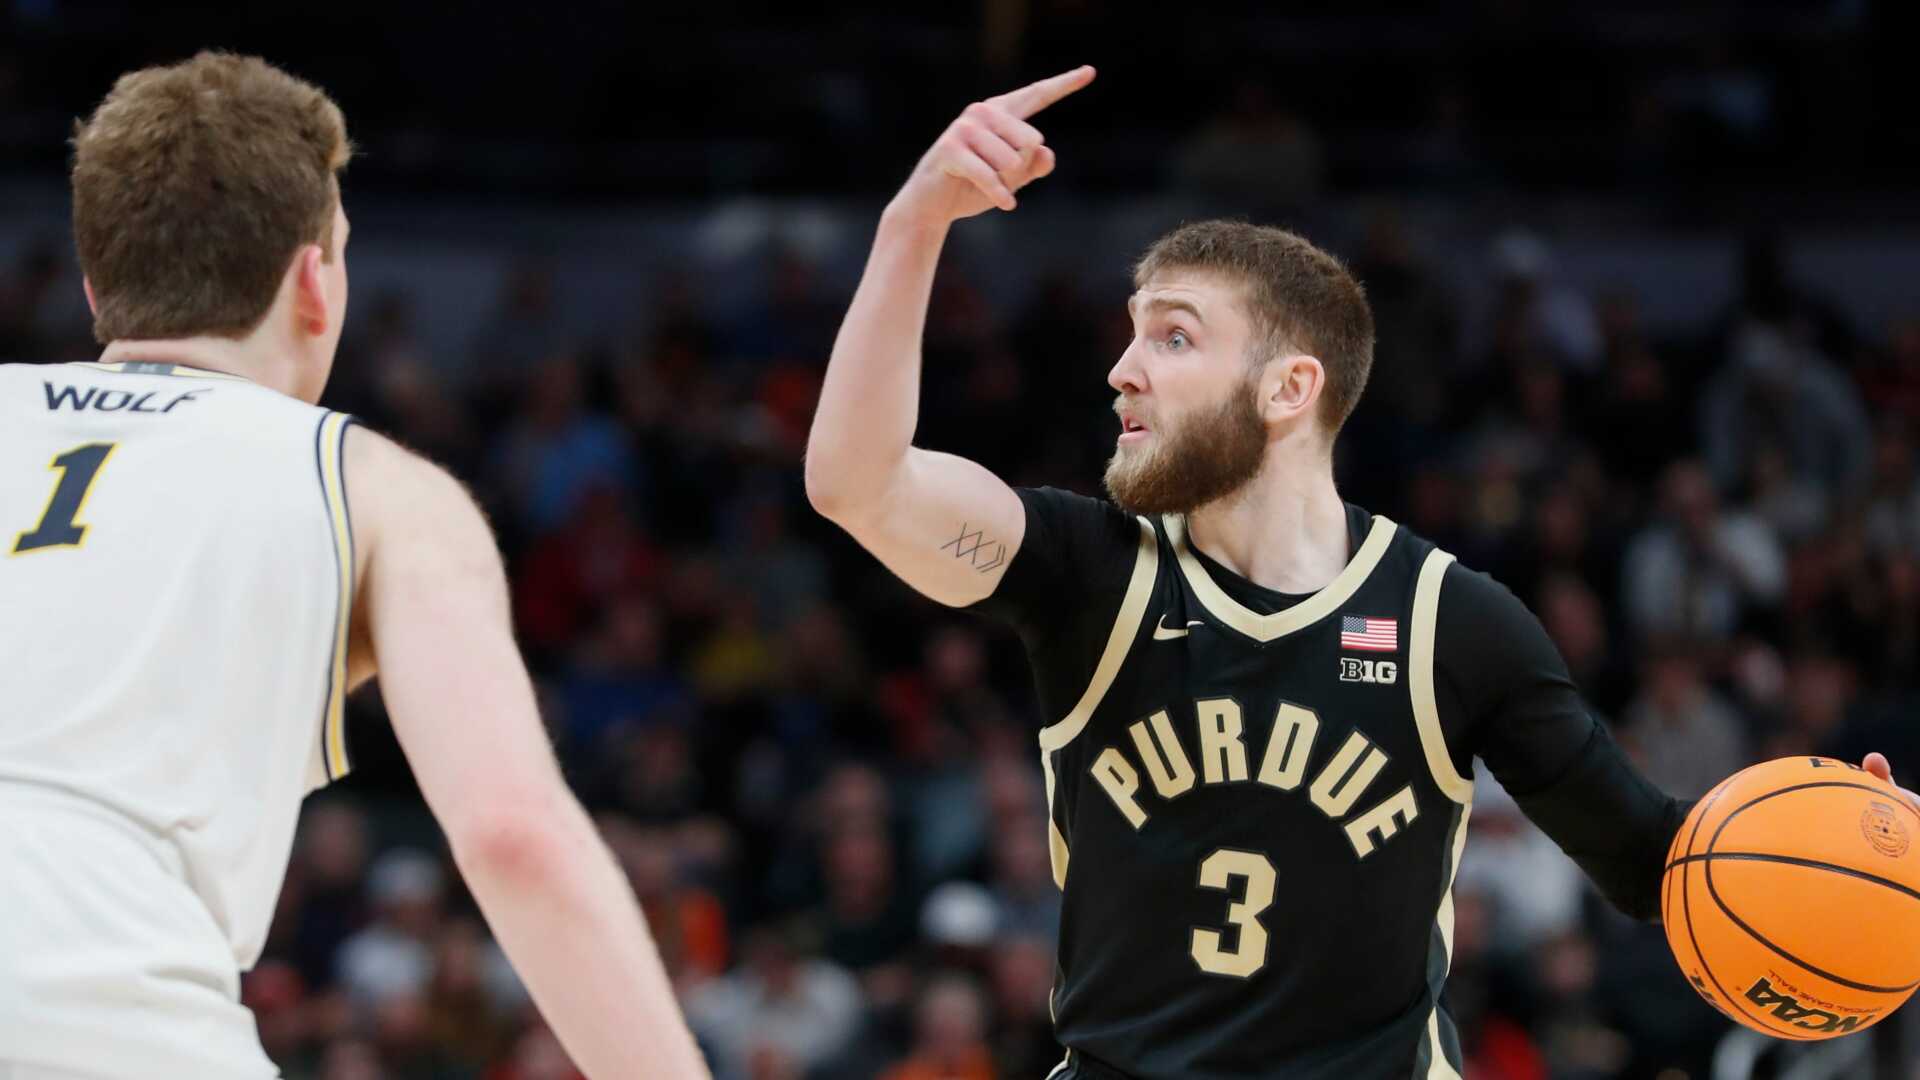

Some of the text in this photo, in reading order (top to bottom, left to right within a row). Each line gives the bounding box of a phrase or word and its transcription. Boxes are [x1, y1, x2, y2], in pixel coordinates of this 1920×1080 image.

[43, 380, 214, 413] WOLF
[11, 442, 120, 556] 1
[1088, 696, 1420, 859] PURDUE
[1189, 847, 1279, 979] 3
[1744, 976, 1876, 1033] NCAA
[1768, 968, 1799, 993] BALL
